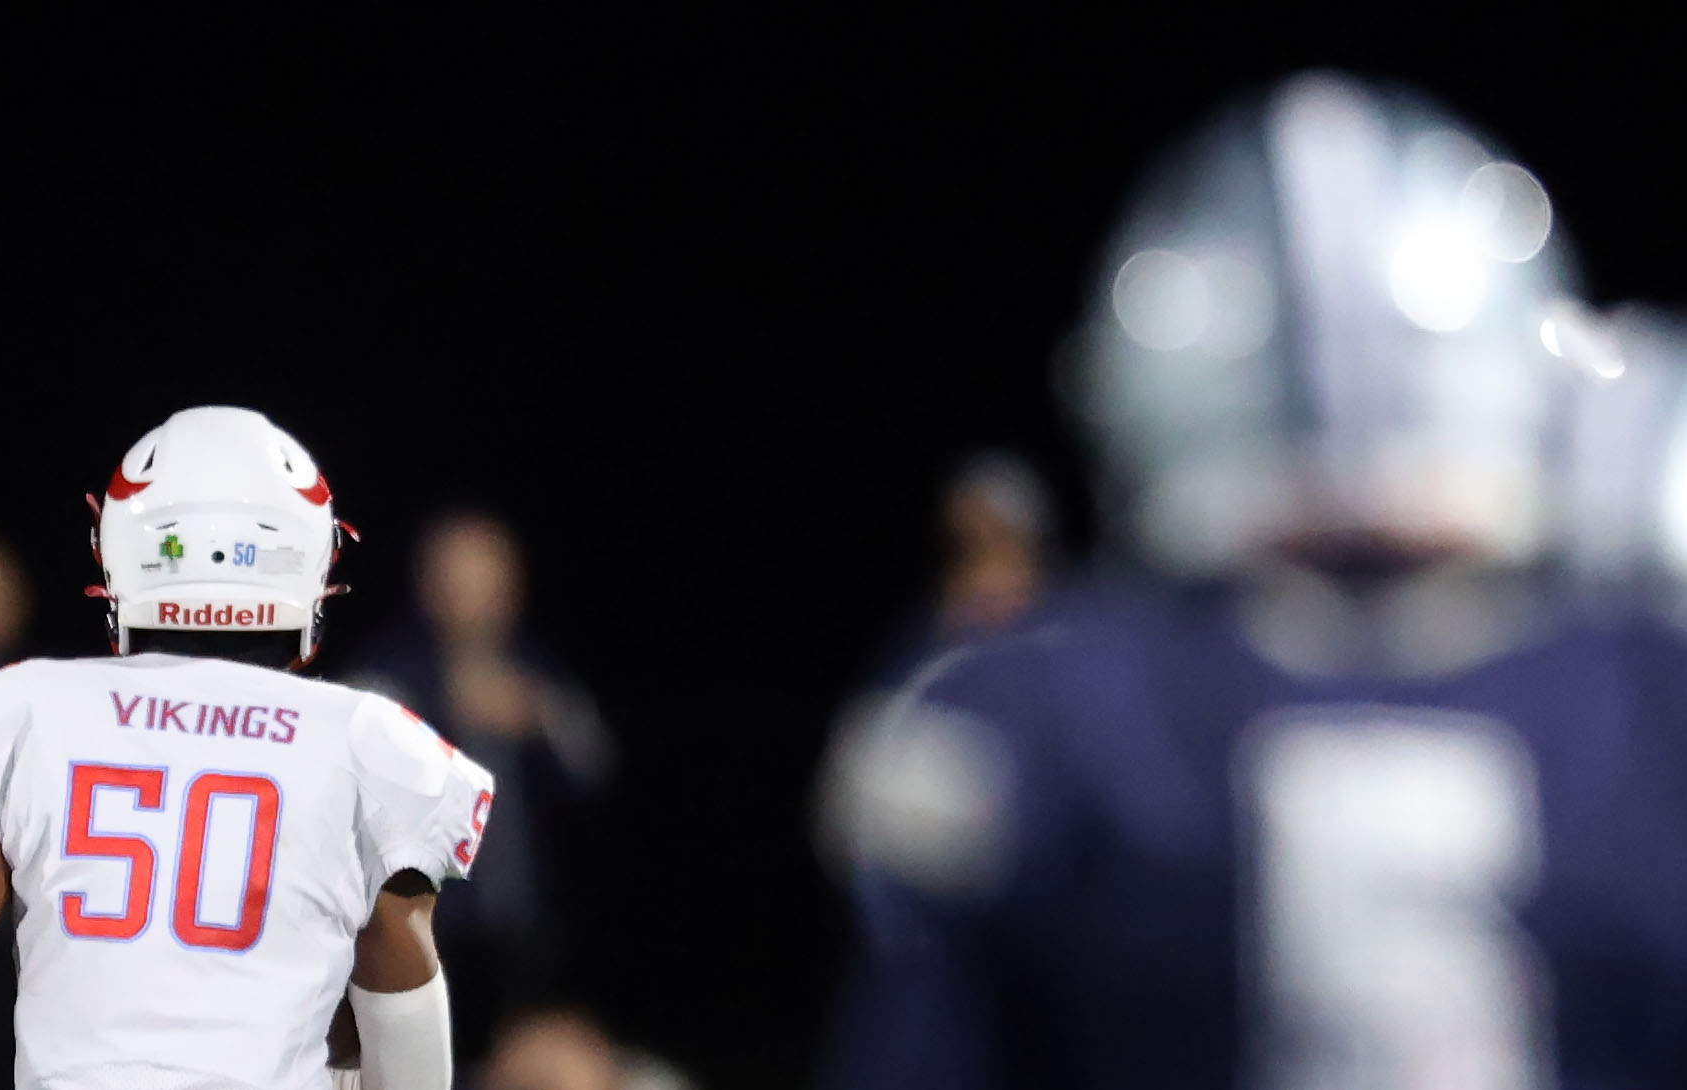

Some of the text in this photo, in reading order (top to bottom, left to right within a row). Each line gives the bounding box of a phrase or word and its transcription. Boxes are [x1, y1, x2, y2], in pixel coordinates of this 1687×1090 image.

[232, 542, 257, 568] 50
[158, 602, 276, 627] Riddell
[109, 690, 300, 745] VIKINGS
[59, 760, 282, 954] 50
